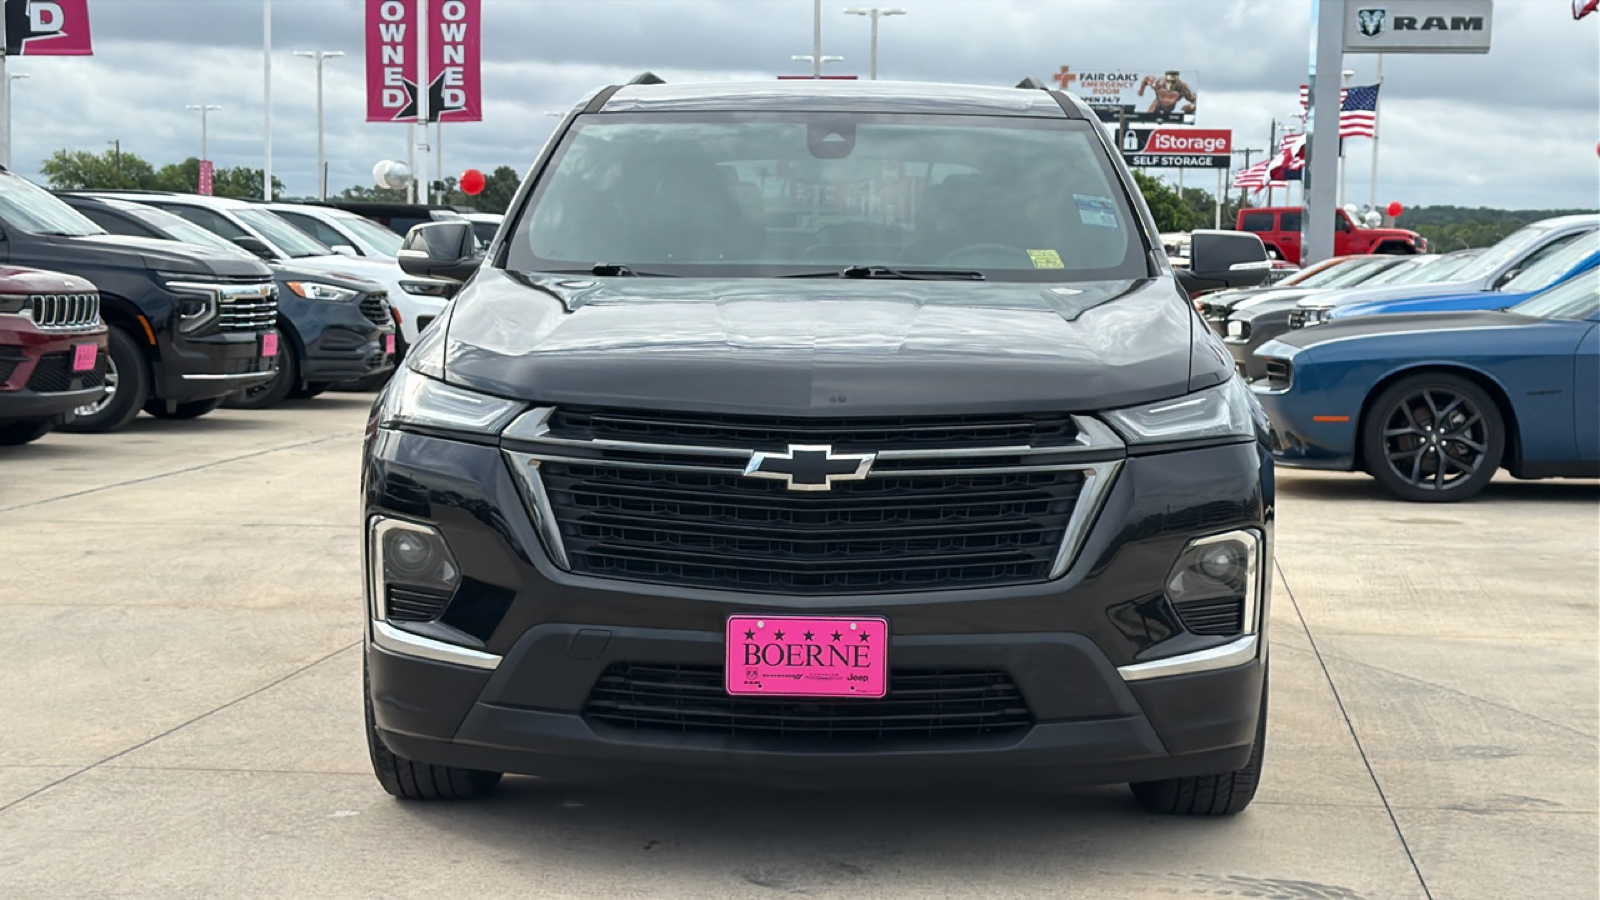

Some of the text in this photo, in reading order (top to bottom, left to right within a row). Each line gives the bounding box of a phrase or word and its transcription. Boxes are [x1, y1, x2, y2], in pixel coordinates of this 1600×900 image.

[1393, 16, 1484, 31] RAM
[379, 0, 407, 108] OWNED
[440, 0, 468, 108] OWNED
[1080, 73, 1139, 82] FAIR OAKS
[1081, 81, 1134, 89] EMERGENCY
[1155, 134, 1227, 152] iStorage
[1133, 155, 1214, 166] SELF STORAGE
[743, 643, 871, 668] BOERNE
[846, 673, 869, 682] Jeep
